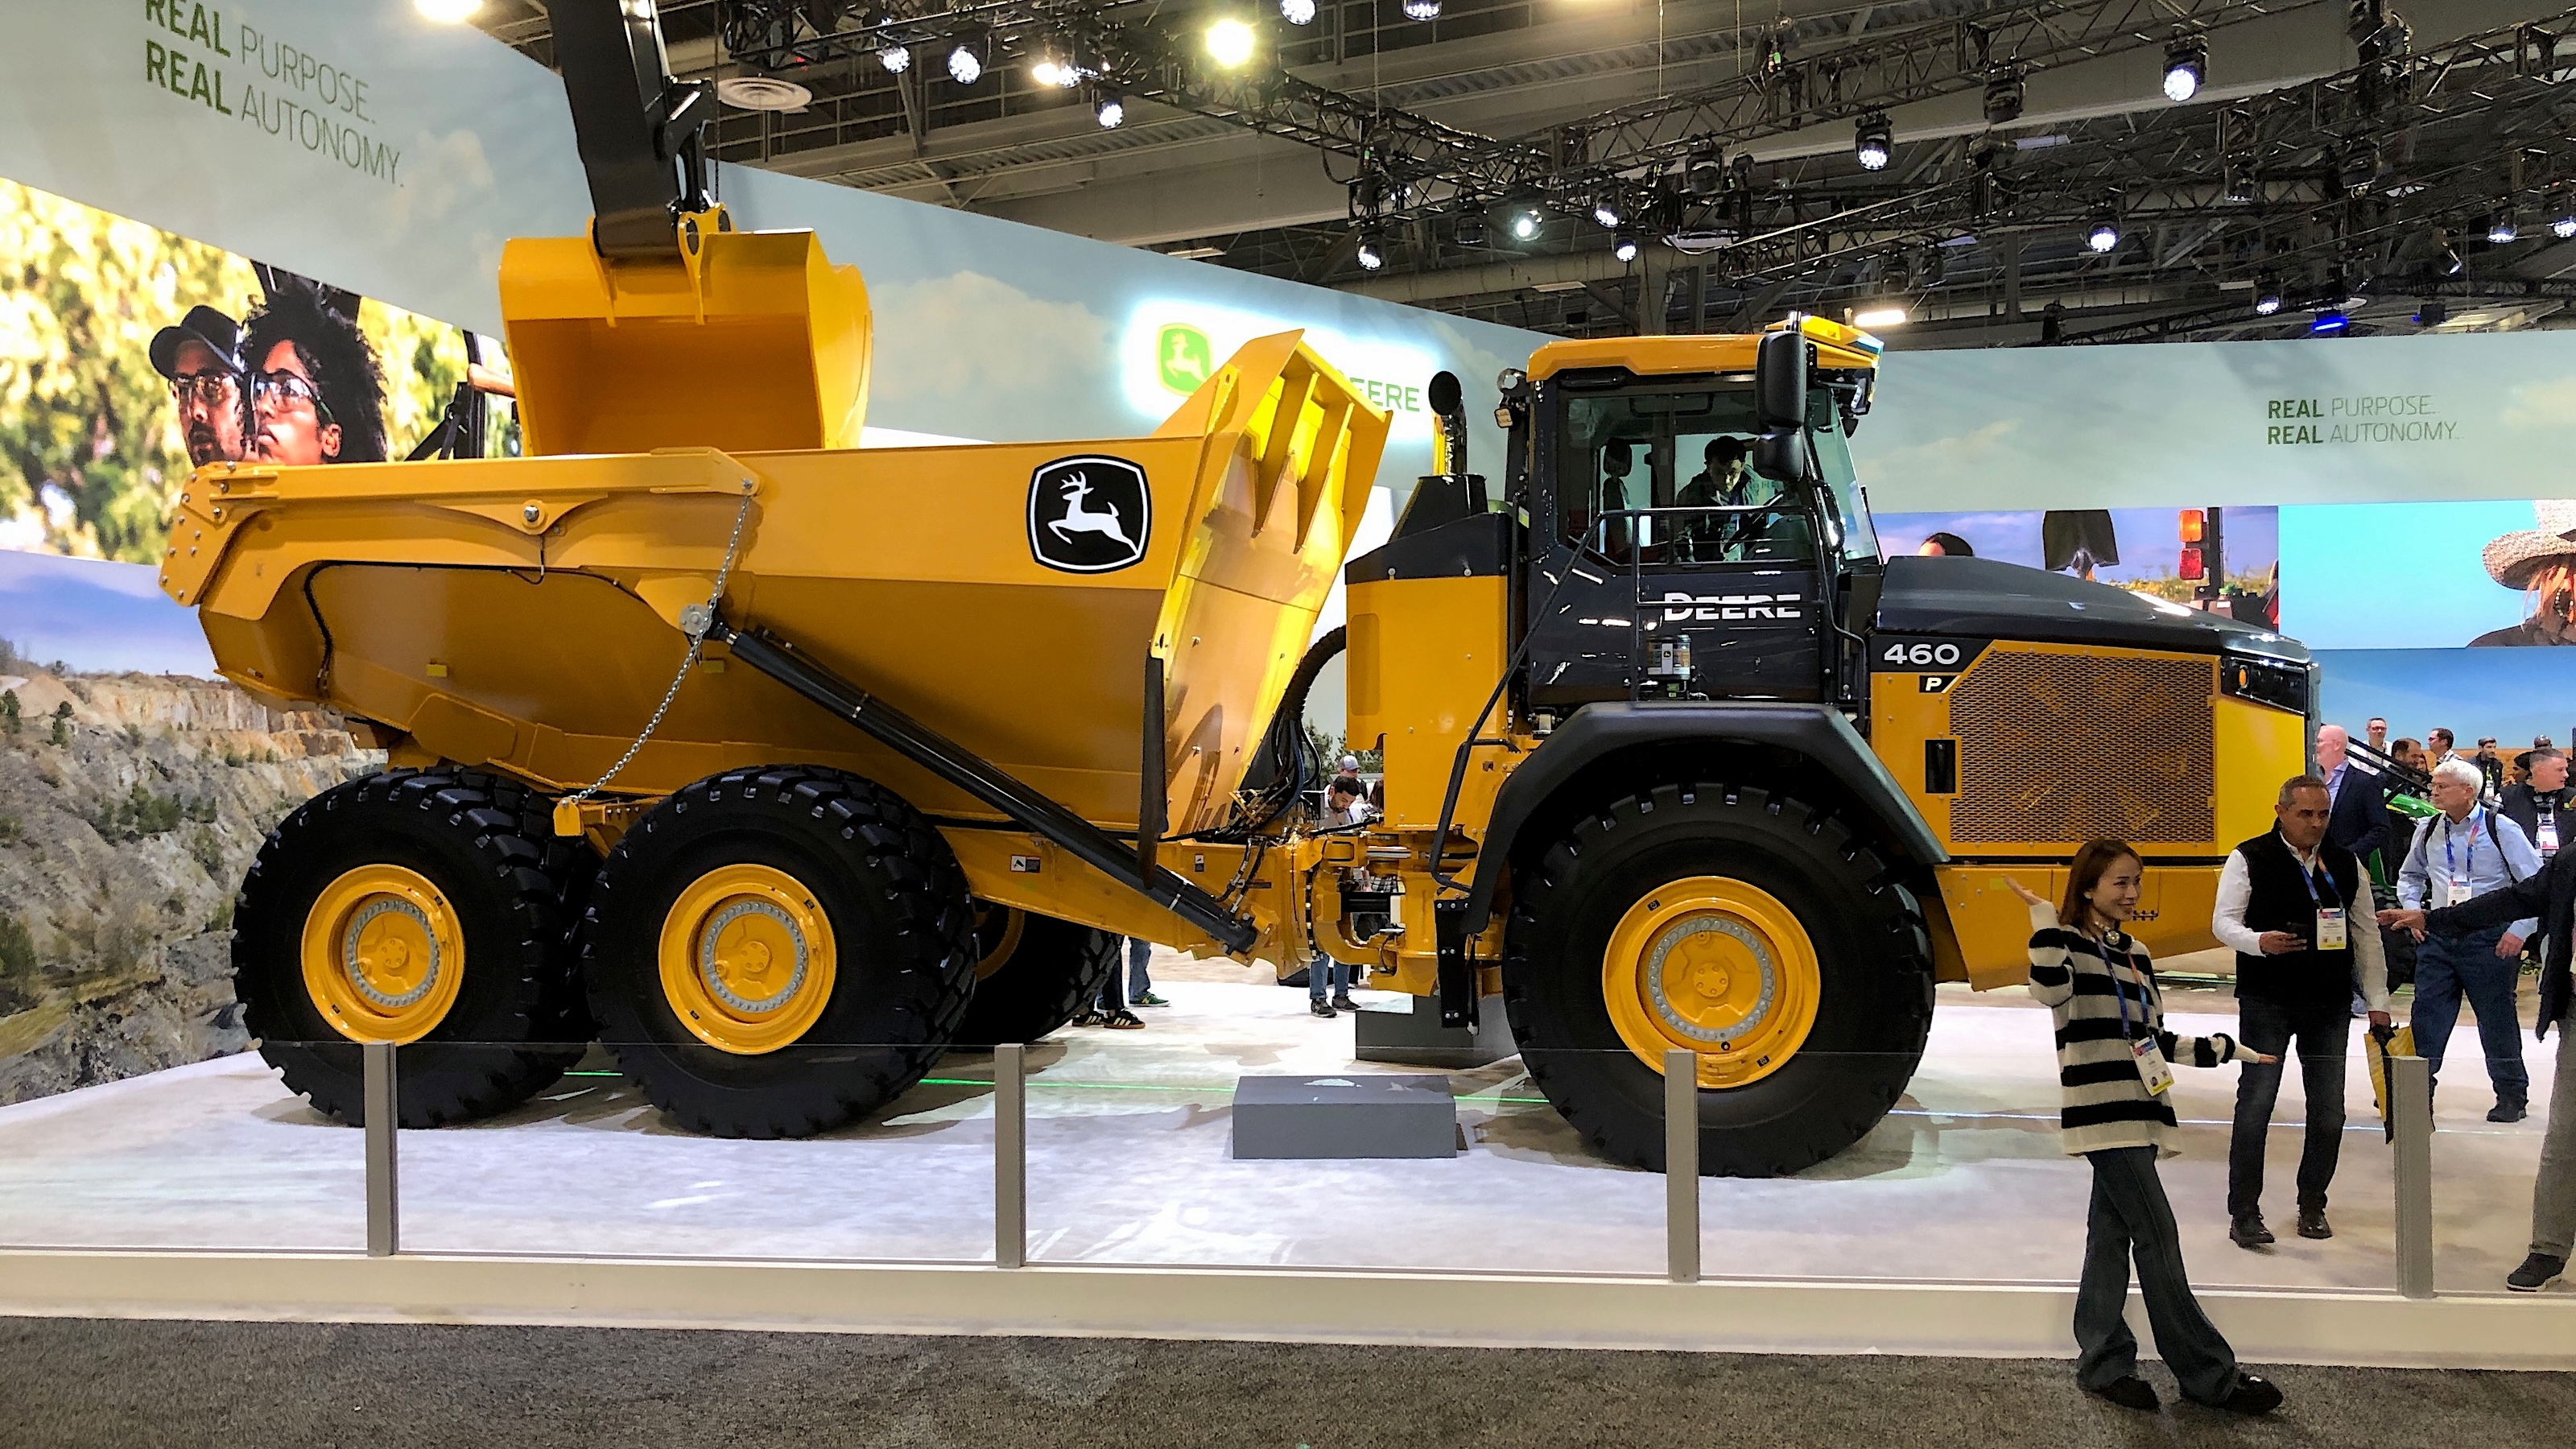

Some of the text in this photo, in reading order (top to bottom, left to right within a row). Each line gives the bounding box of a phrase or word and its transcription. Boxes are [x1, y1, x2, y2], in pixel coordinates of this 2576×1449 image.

[146, 0, 377, 125] REAL PURPOSE.
[146, 39, 405, 188] REAL AUTONOMY.
[2267, 394, 2440, 419] REAL PURPOSE.
[2267, 421, 2463, 445] REAL AUTONOMY.
[1664, 592, 1802, 621] DEERE
[1884, 643, 1961, 665] 460
[1925, 677, 1942, 691] P
